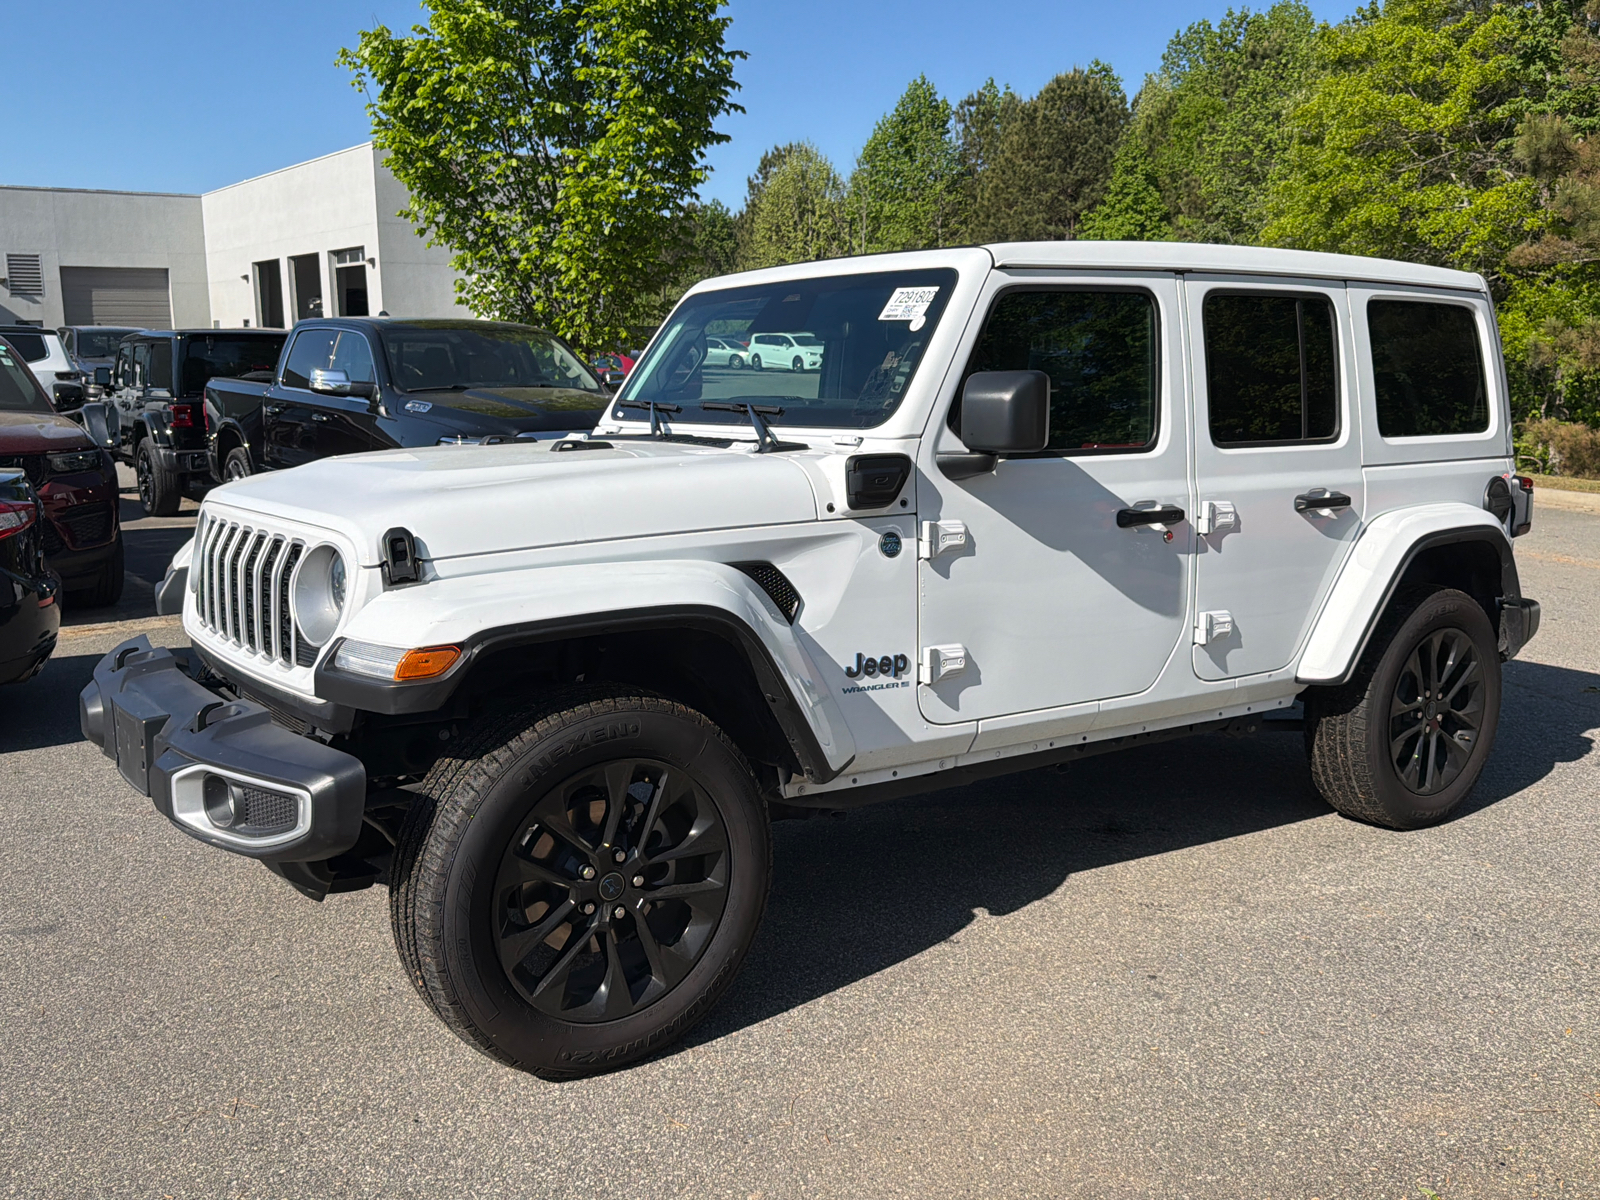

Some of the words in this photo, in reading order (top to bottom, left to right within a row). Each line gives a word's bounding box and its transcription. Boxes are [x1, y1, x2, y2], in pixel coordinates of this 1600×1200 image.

[894, 290, 937, 304] 7291802
[845, 652, 908, 679] Jeep
[841, 682, 900, 695] WRANGLER
[528, 721, 629, 781] NEXEN
